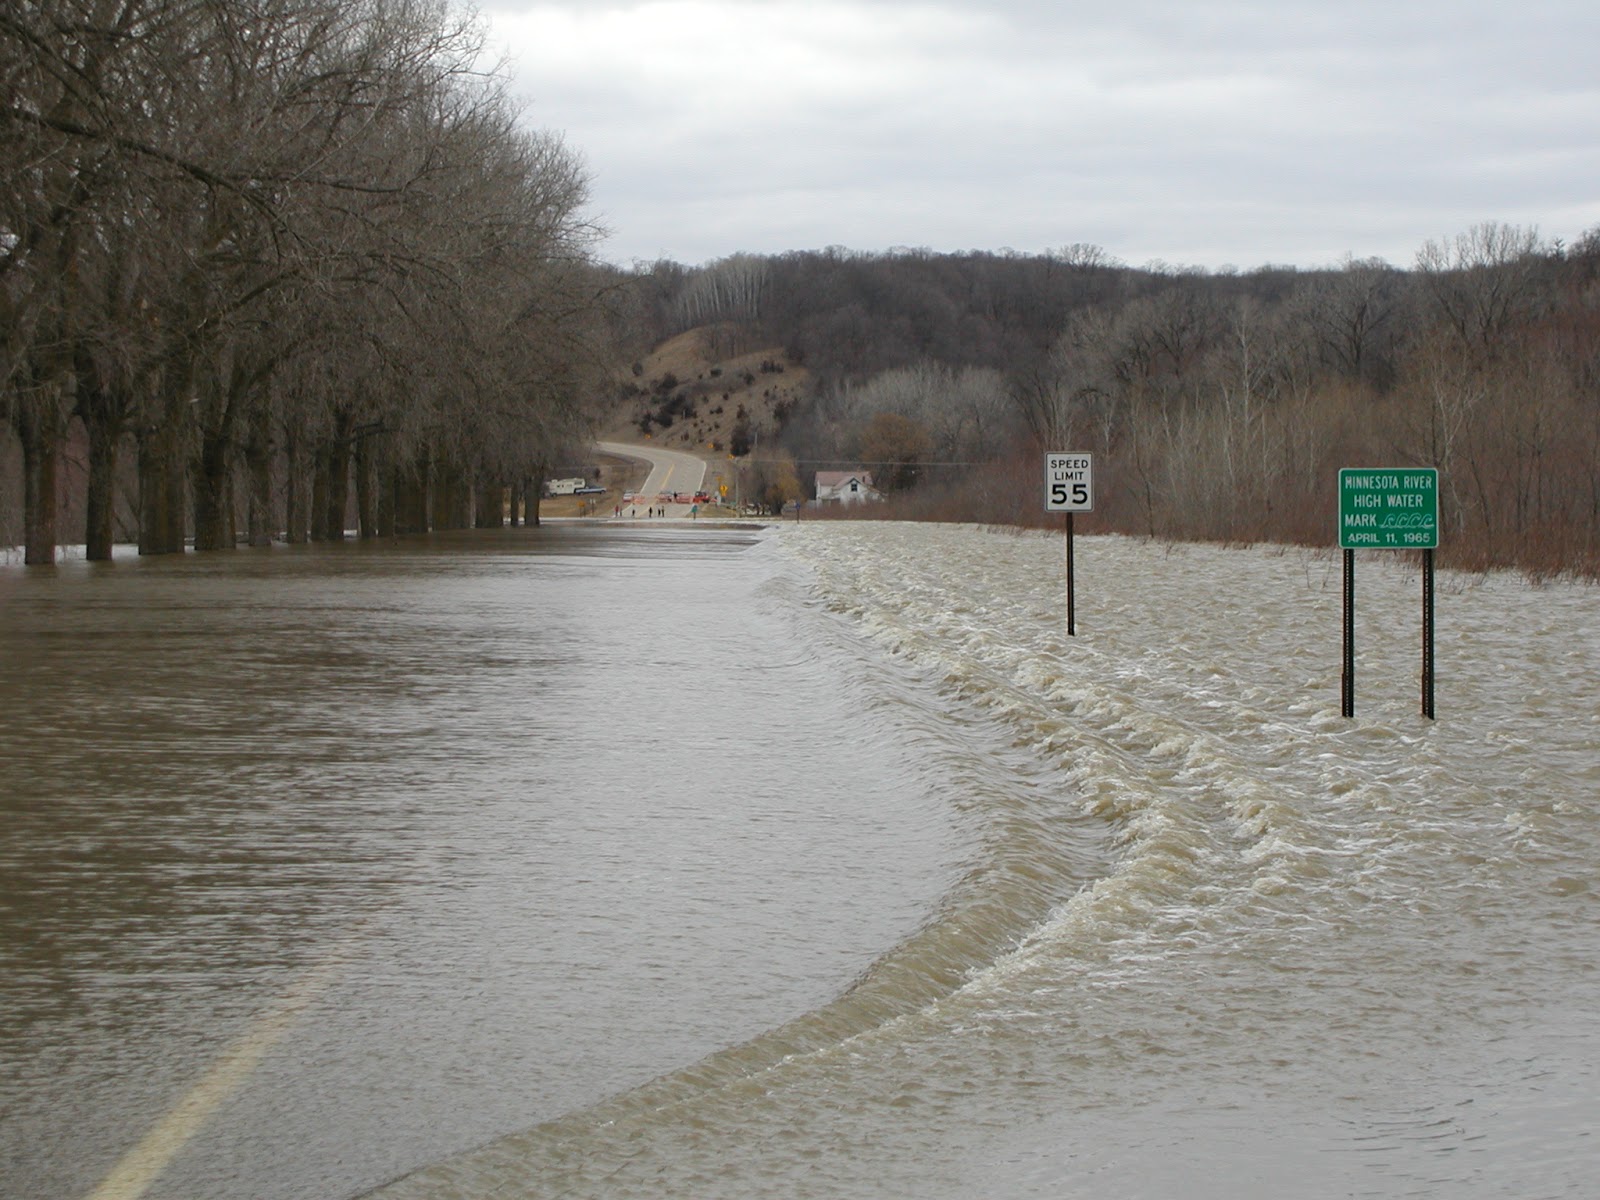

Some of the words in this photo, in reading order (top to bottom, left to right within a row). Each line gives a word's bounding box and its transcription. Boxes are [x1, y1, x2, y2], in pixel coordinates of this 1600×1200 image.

[1050, 459, 1088, 469] SPEED
[1054, 472, 1084, 481] LIMIT
[1345, 475, 1399, 489] MINNESOTA
[1403, 475, 1432, 489] RIVER
[1051, 484, 1088, 505] 55
[1353, 494, 1382, 508] HIGH
[1386, 494, 1423, 508] WATER
[1344, 513, 1377, 527] MARK
[1348, 533, 1380, 543] APRIL
[1385, 533, 1398, 544] 11,
[1403, 532, 1430, 543] 1965
